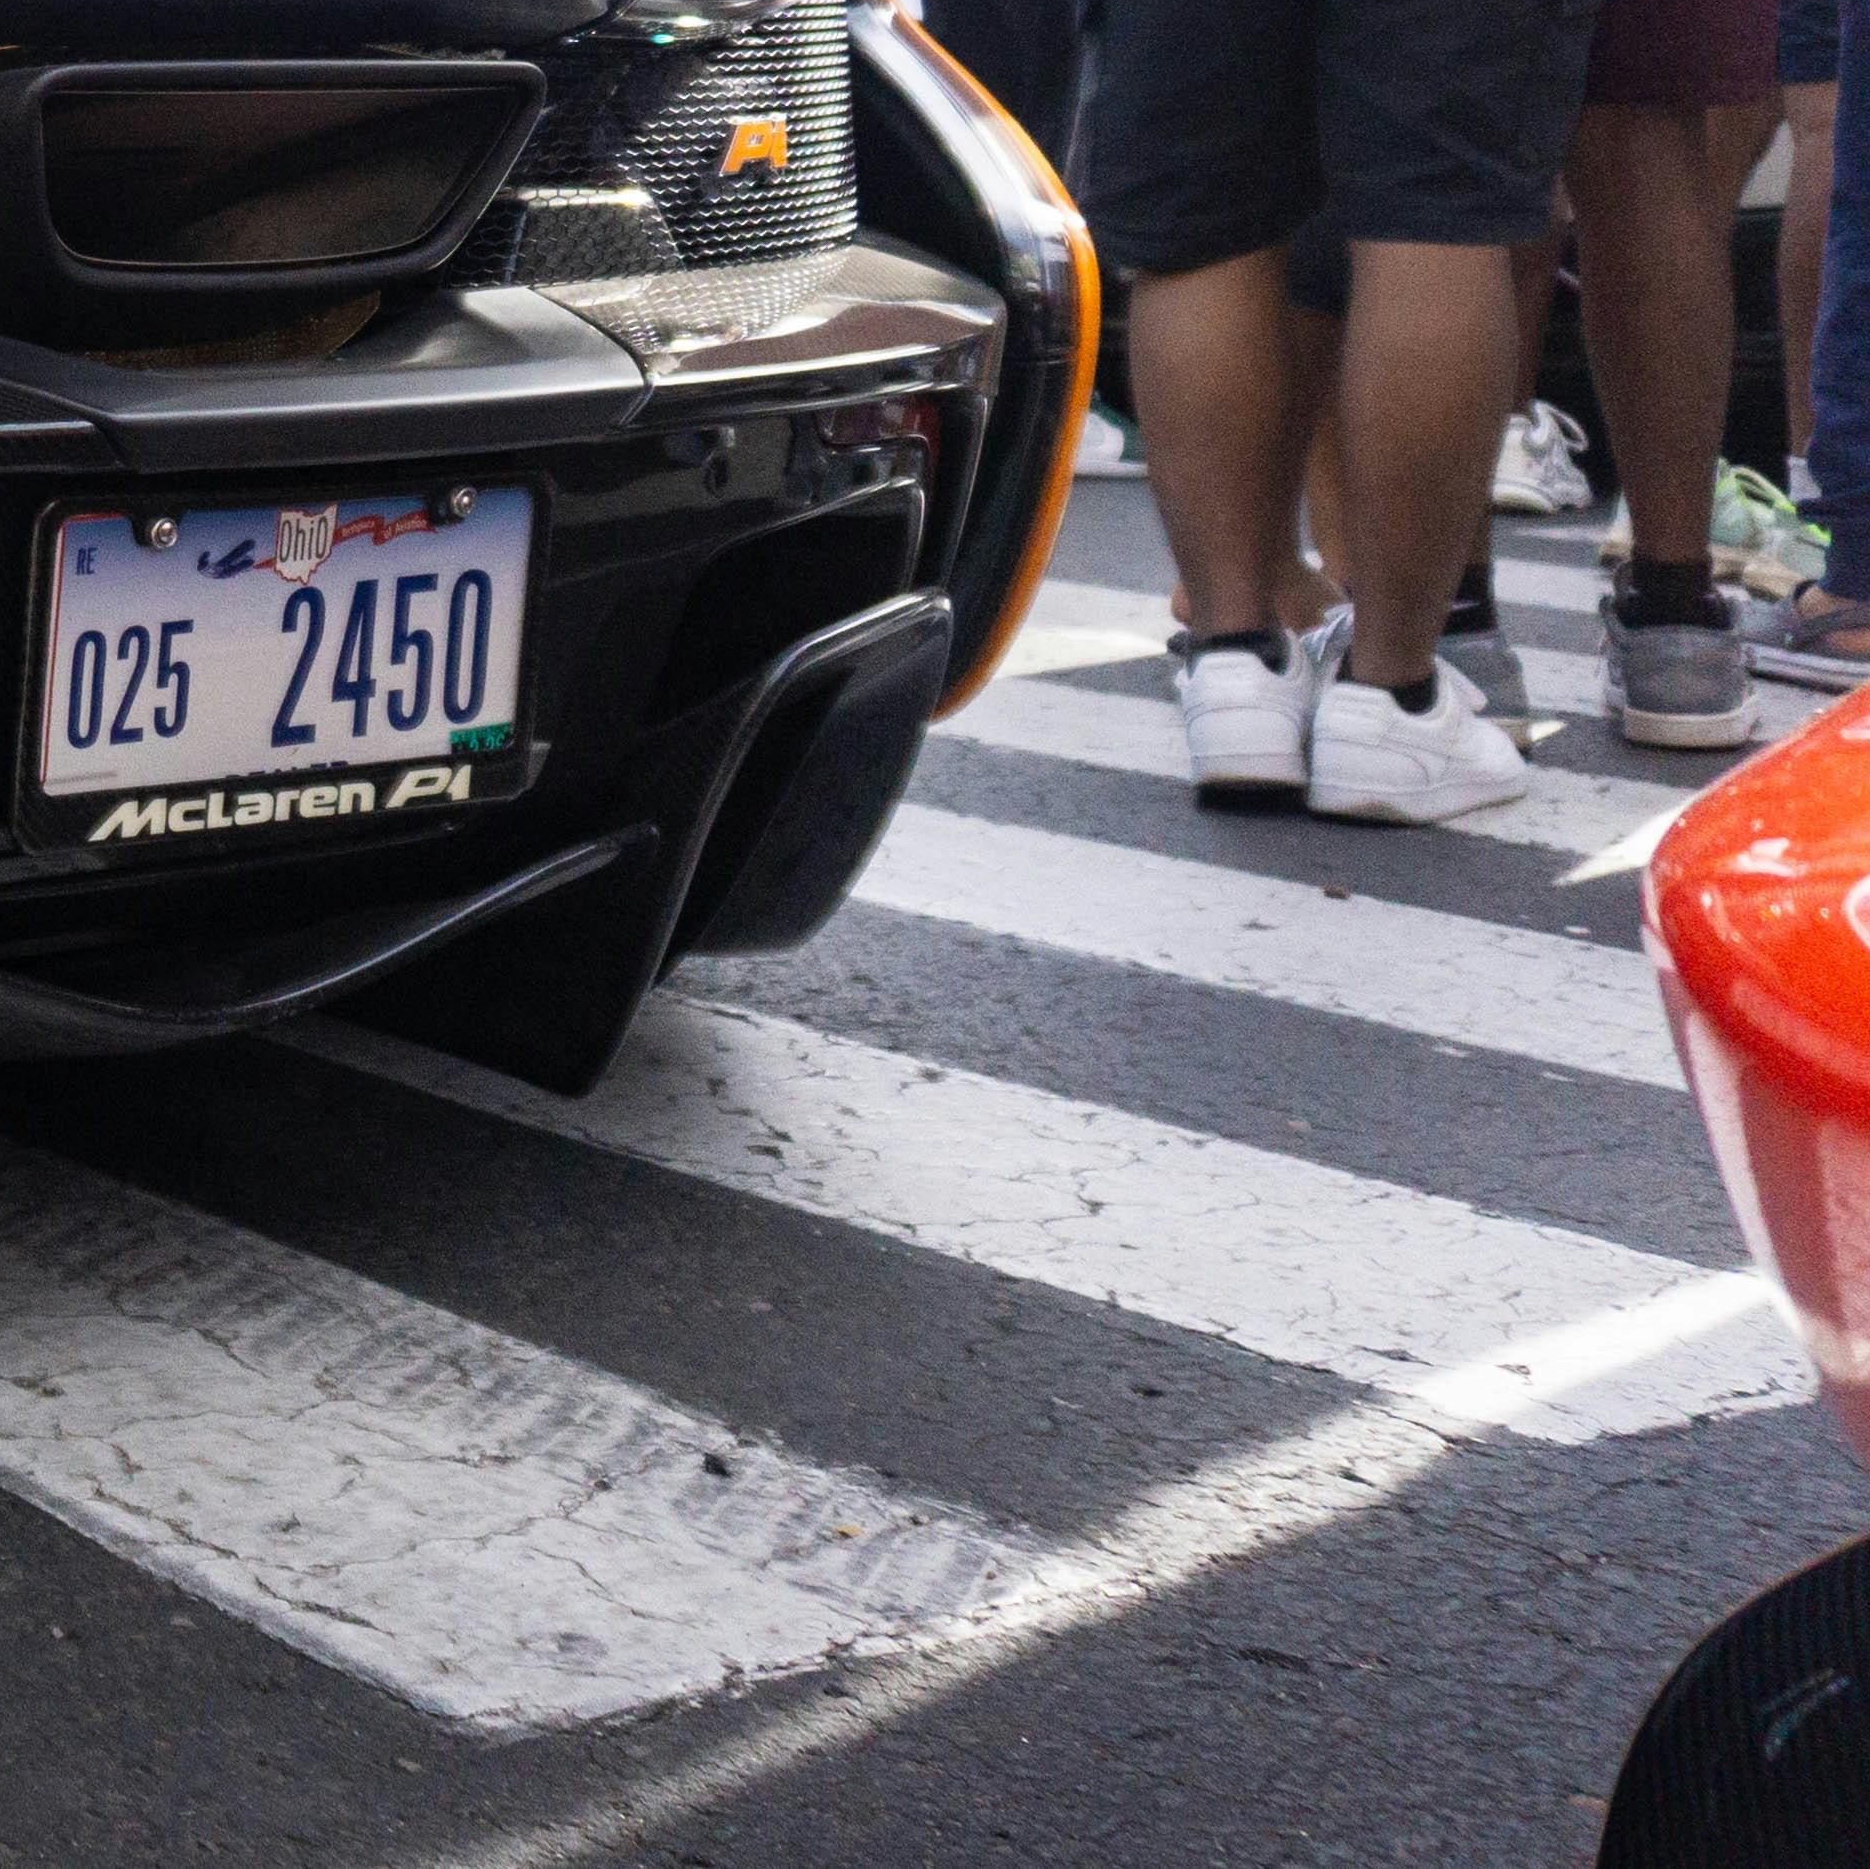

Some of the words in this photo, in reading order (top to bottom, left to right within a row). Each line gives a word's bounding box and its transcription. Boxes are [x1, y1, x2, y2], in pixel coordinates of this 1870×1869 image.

[68, 619, 194, 749] 025
[270, 568, 493, 748] 2450
[87, 781, 376, 843] McLaren
[386, 764, 472, 811] P1
